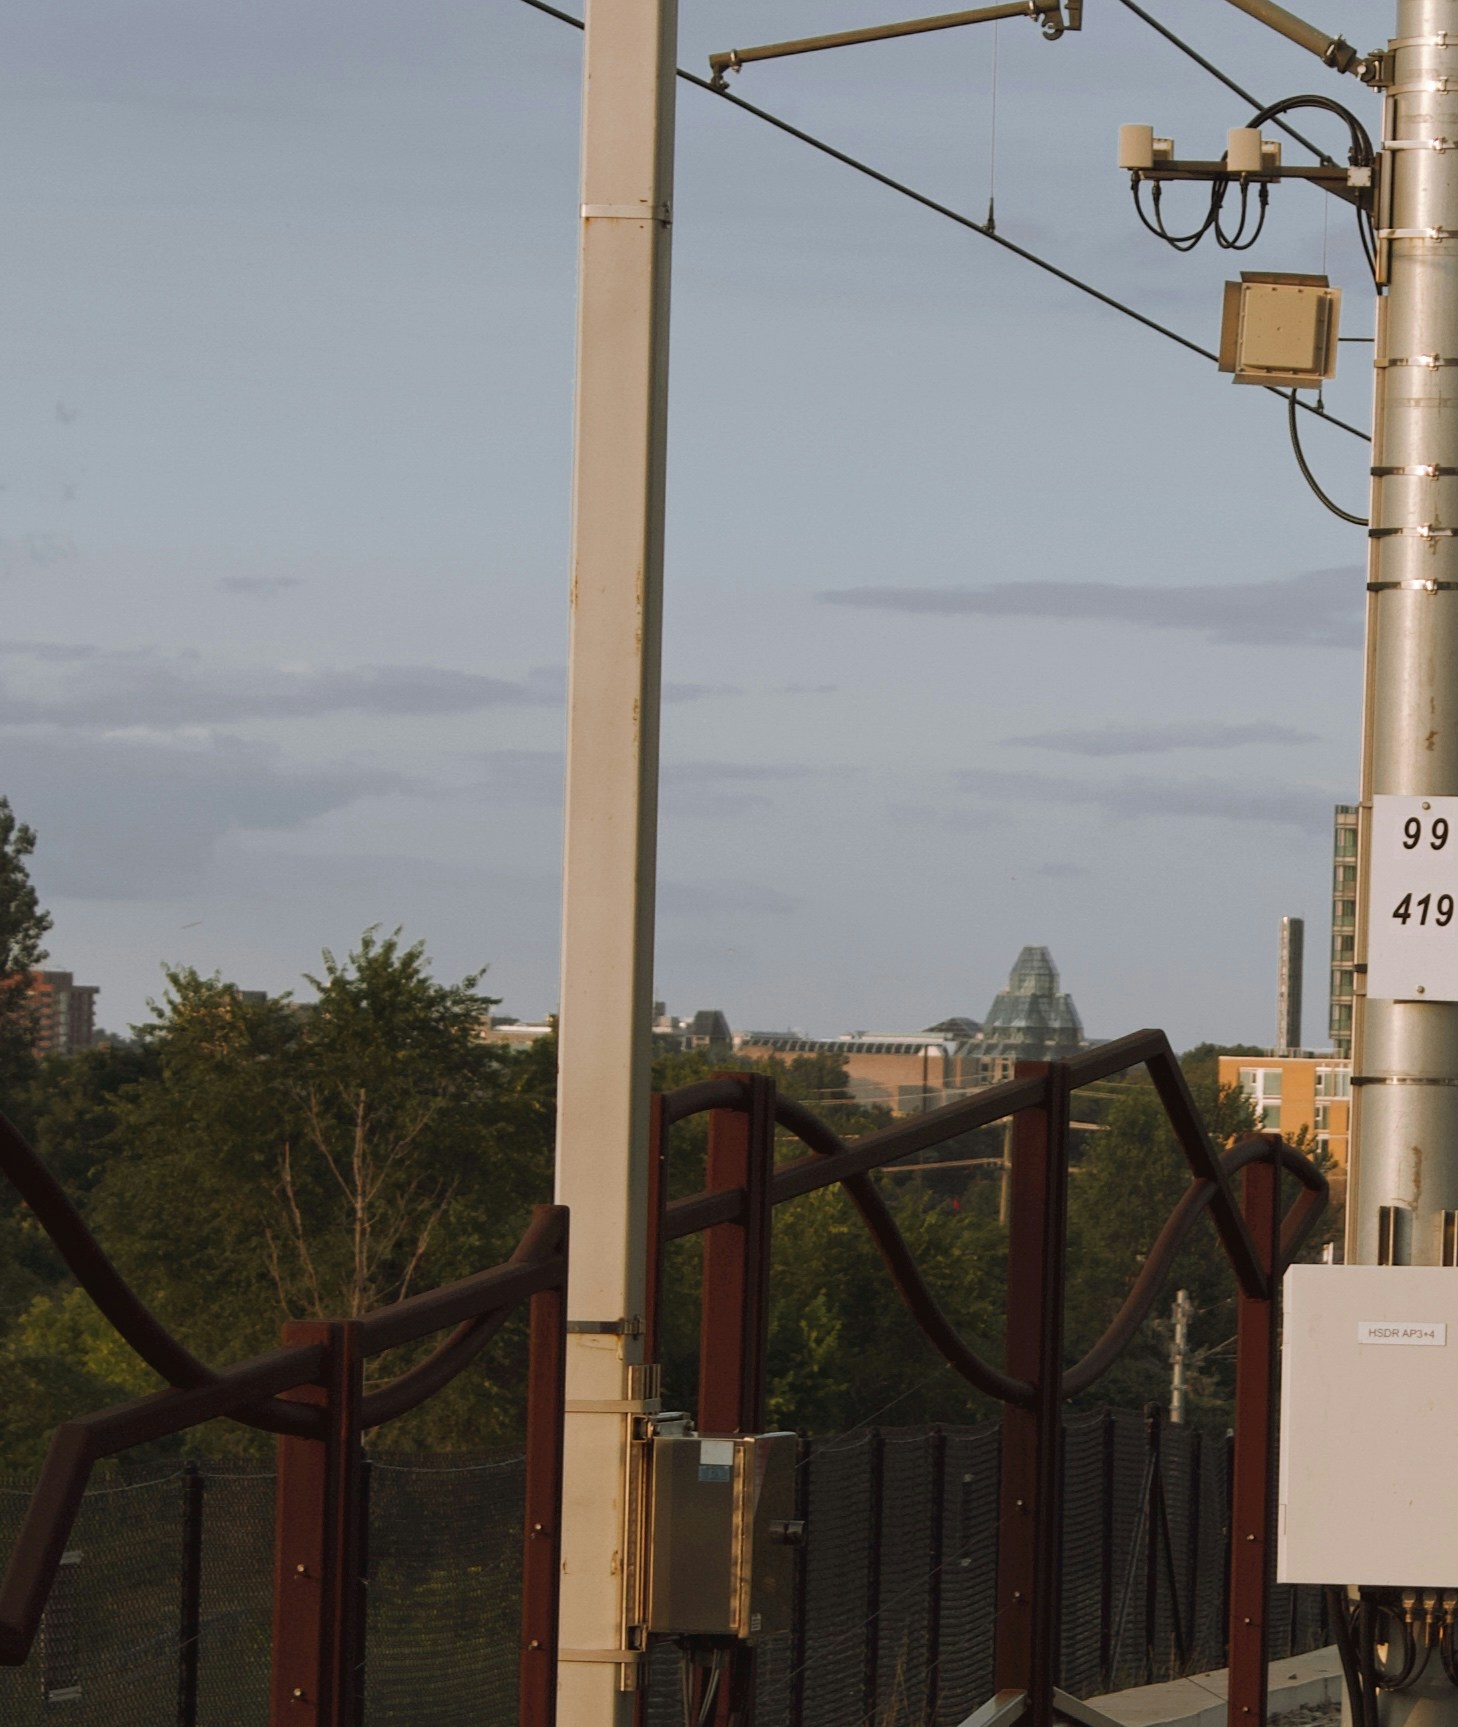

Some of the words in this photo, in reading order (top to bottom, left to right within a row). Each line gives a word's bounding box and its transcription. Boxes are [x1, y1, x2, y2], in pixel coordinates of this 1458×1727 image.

[1402, 816, 1450, 850] 99
[1392, 892, 1455, 927] 419
[1368, 1328, 1400, 1338] HSDR
